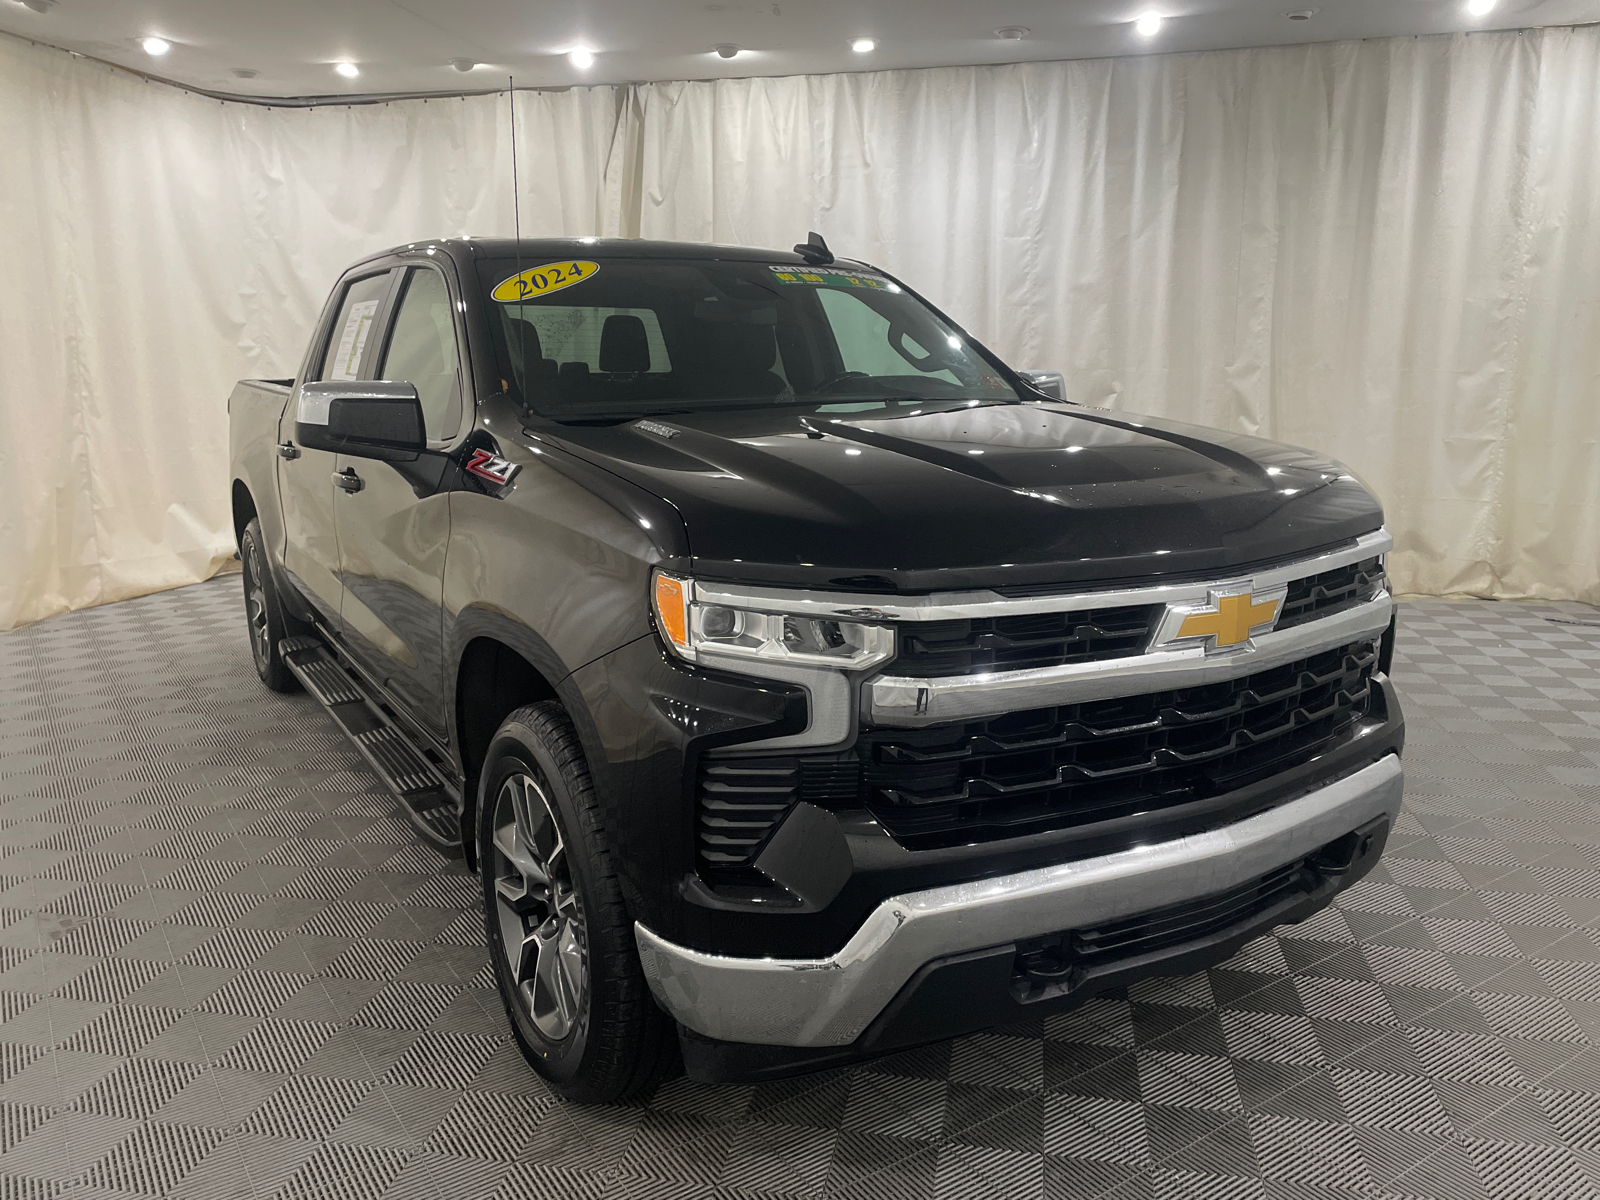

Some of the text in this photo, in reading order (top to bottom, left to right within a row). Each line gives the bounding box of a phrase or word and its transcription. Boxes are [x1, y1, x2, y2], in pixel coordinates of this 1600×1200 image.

[513, 262, 583, 297] 2024
[768, 265, 828, 275] CERTIFIED
[465, 448, 523, 487] Z71
